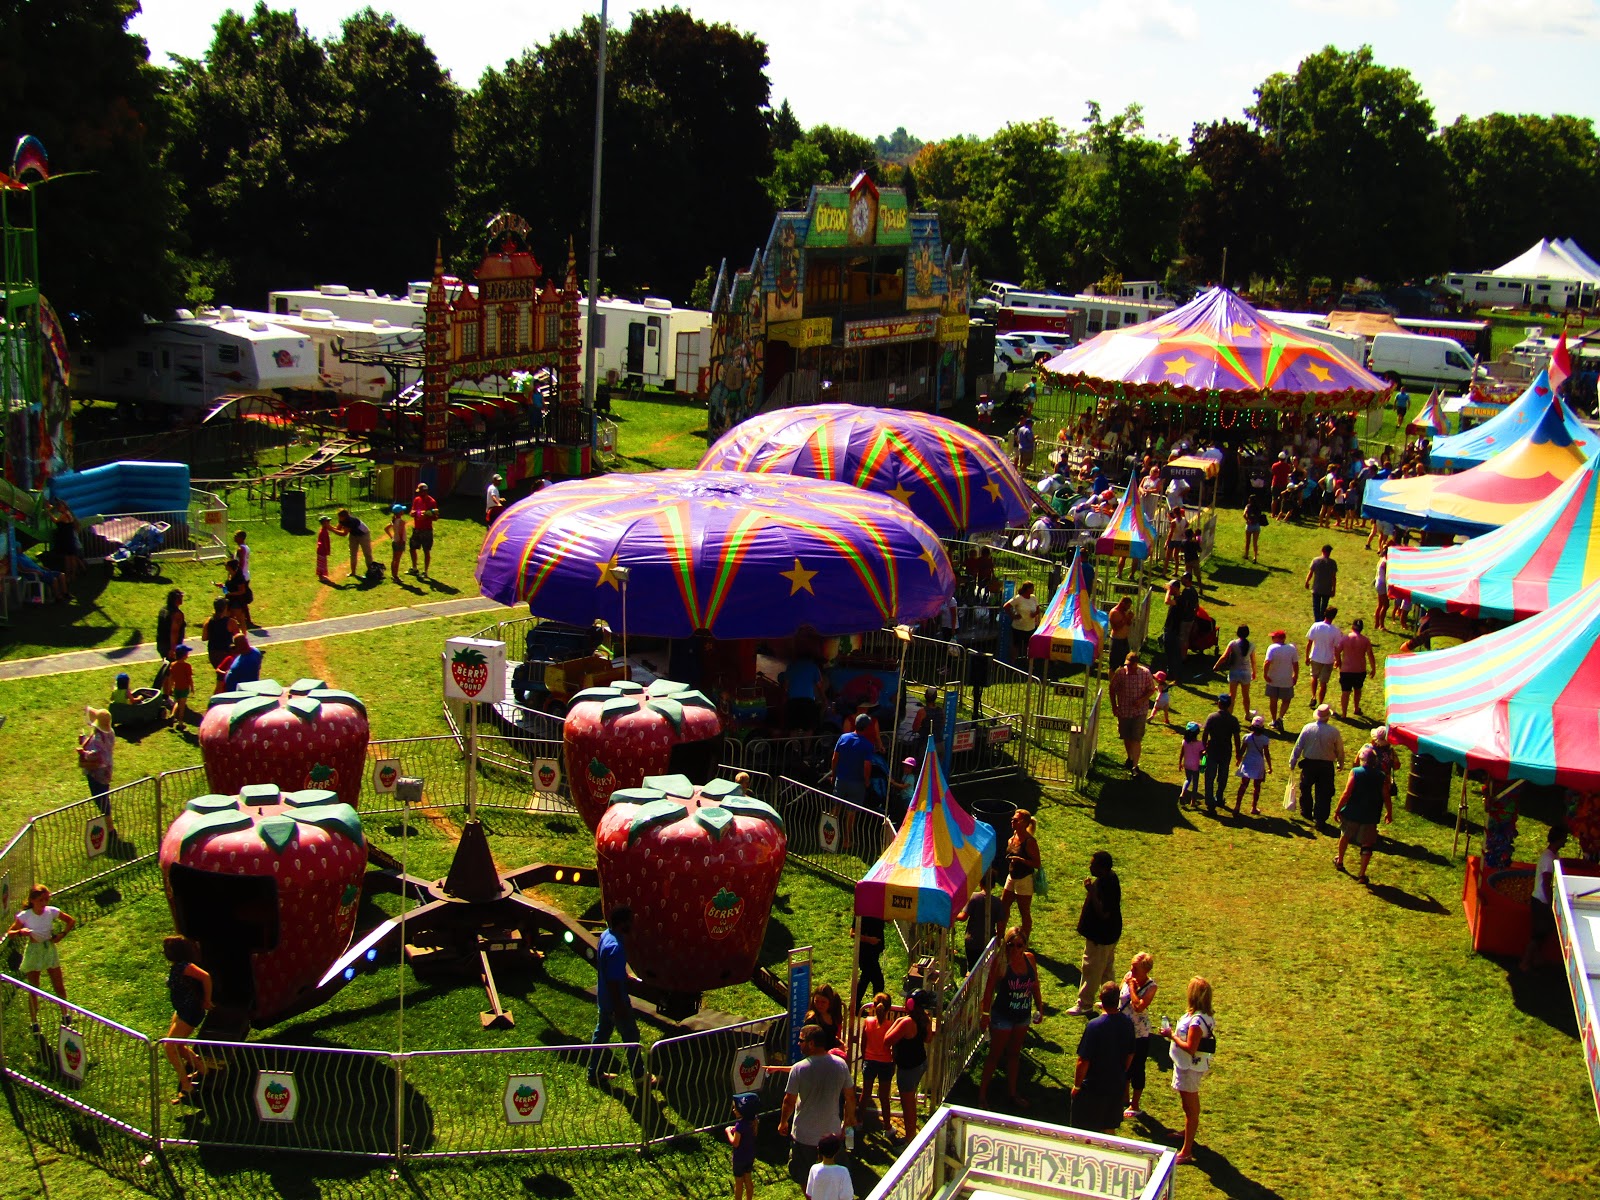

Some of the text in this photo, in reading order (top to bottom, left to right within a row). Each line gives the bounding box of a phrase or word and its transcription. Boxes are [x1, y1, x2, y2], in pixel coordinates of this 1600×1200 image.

[485, 281, 533, 300] EXPRESS
[1052, 644, 1072, 654] ENTER
[457, 666, 485, 678] BERRY
[460, 681, 482, 690] ROUND
[1057, 687, 1083, 697] EXIT
[1040, 720, 1069, 730] ENTRANCE
[307, 777, 336, 789] BERRY
[588, 772, 612, 785] BERRY
[892, 895, 912, 909] EXIT
[708, 905, 741, 918] BERRY
[267, 1092, 288, 1100] BERRY
[515, 1094, 537, 1103] BERRY
